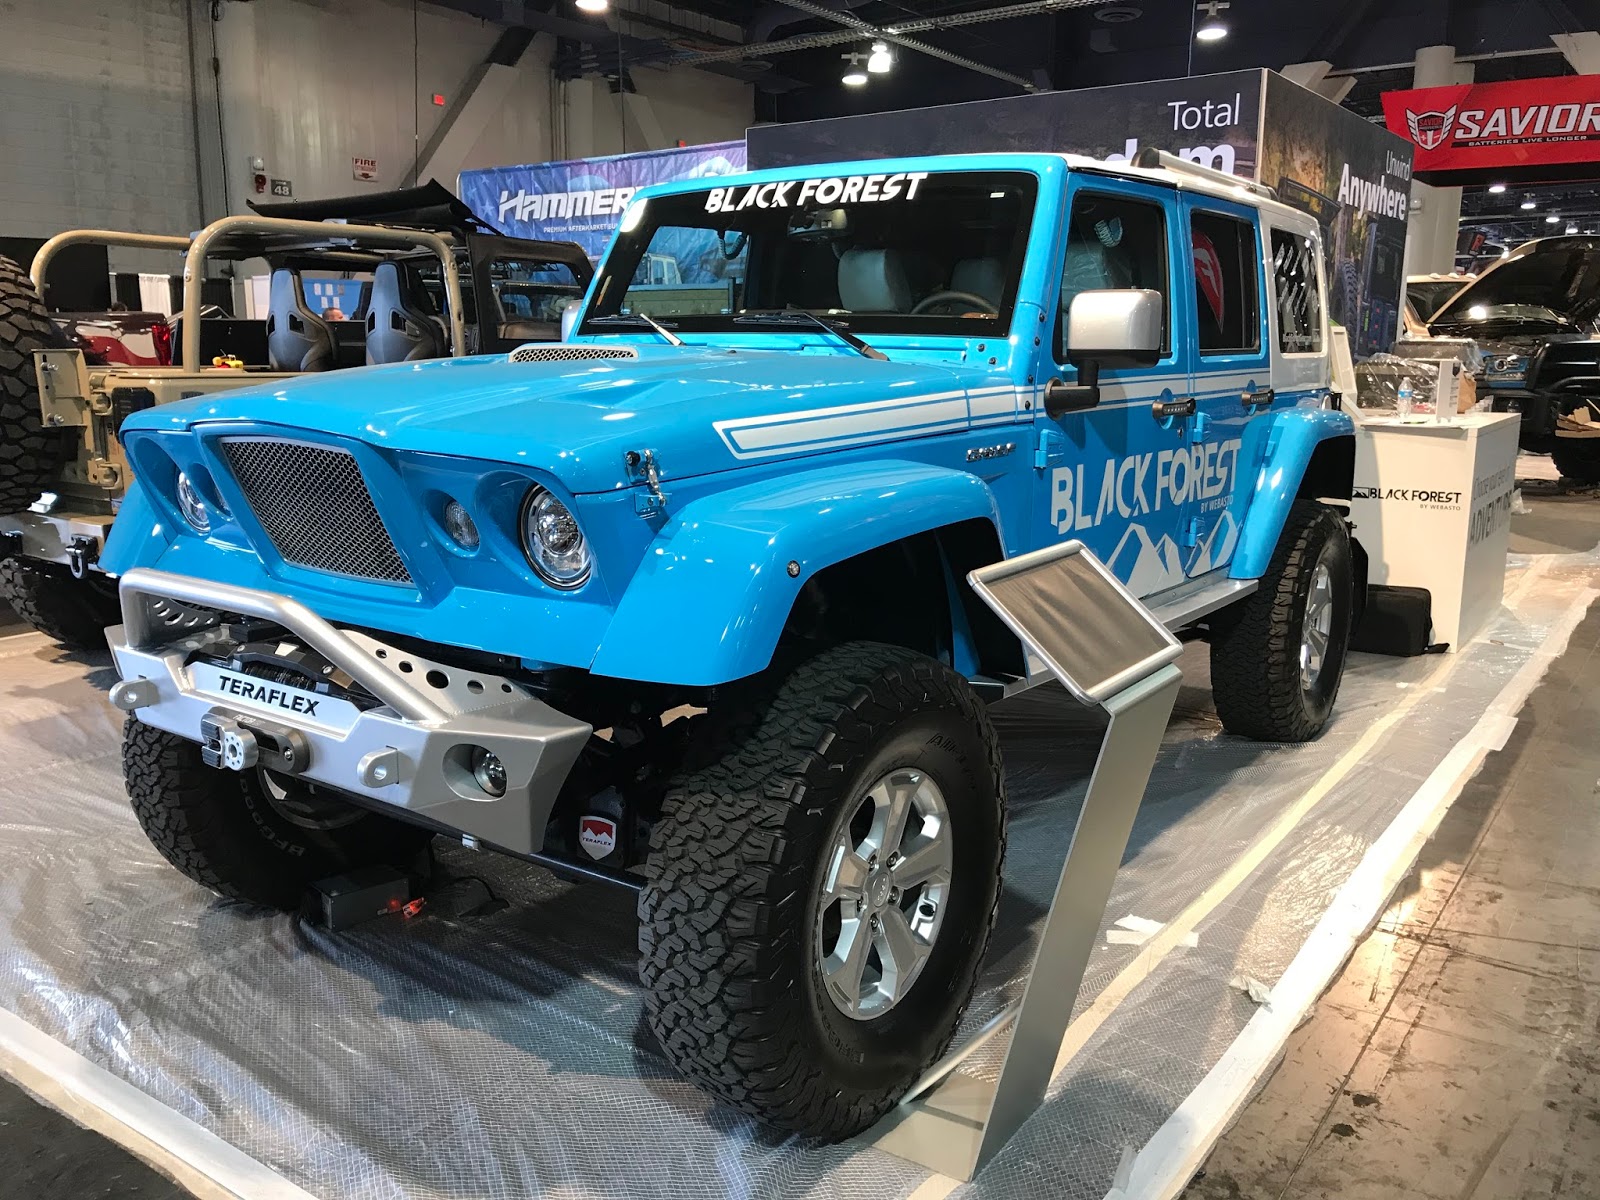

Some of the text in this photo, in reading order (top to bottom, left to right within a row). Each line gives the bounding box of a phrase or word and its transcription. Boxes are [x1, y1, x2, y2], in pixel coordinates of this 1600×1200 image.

[1167, 92, 1241, 131] Total
[1454, 102, 1600, 140] SAVIOR
[1468, 138, 1519, 147] BATTERIES
[354, 158, 377, 167] FIRE
[1385, 149, 1411, 181] Unwind
[274, 185, 290, 196] 48
[704, 172, 928, 214] BLACK FOREST
[1337, 163, 1407, 220] Anywhere
[543, 225, 568, 233] PREMIUM
[568, 222, 607, 232] AFTERMARKET
[1050, 438, 1243, 535] BLACK FOREST
[1369, 487, 1462, 504] BLACK FOREST
[1200, 494, 1234, 513] BY WEBASTO
[219, 675, 320, 717] TERAFLEX
[582, 837, 612, 847] TERAFLEX
